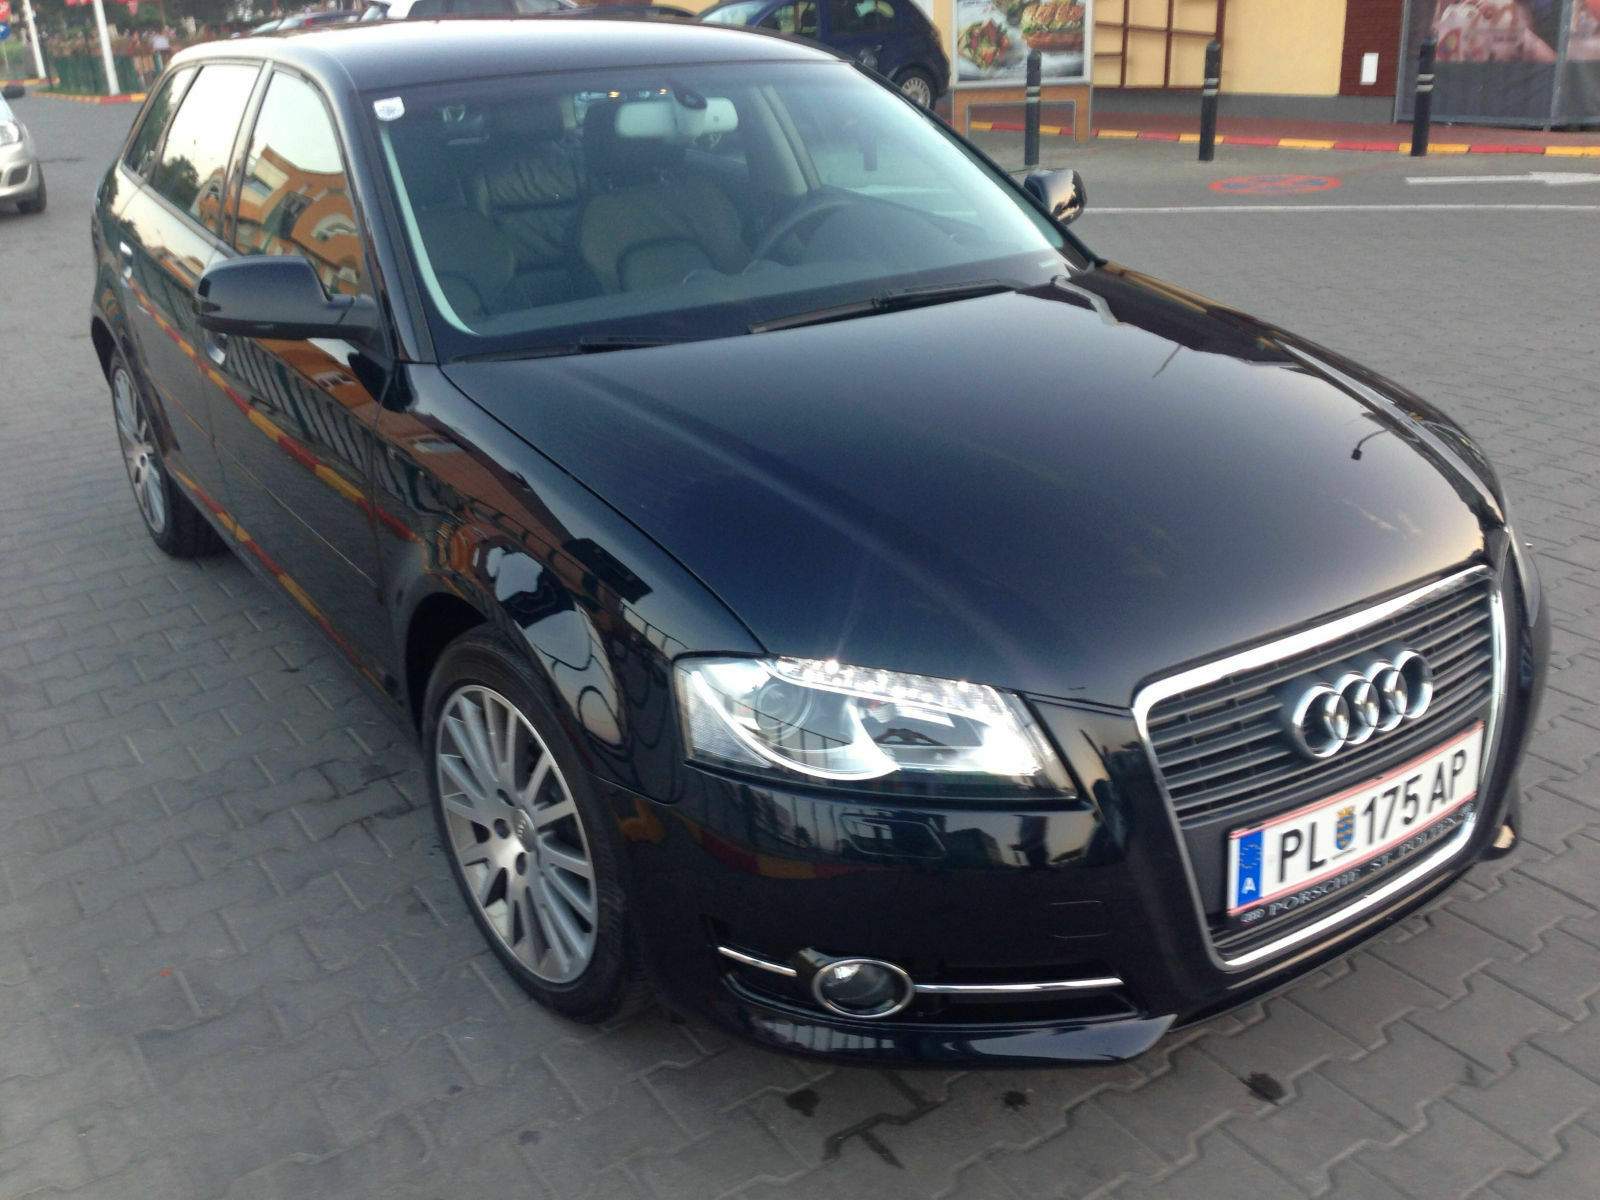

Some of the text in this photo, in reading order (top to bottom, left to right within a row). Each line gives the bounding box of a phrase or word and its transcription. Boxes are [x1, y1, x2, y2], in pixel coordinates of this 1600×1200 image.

[1279, 821, 1326, 883] PL
[1362, 774, 1421, 846] 175
[1428, 749, 1467, 813] AP
[1241, 877, 1257, 895] A
